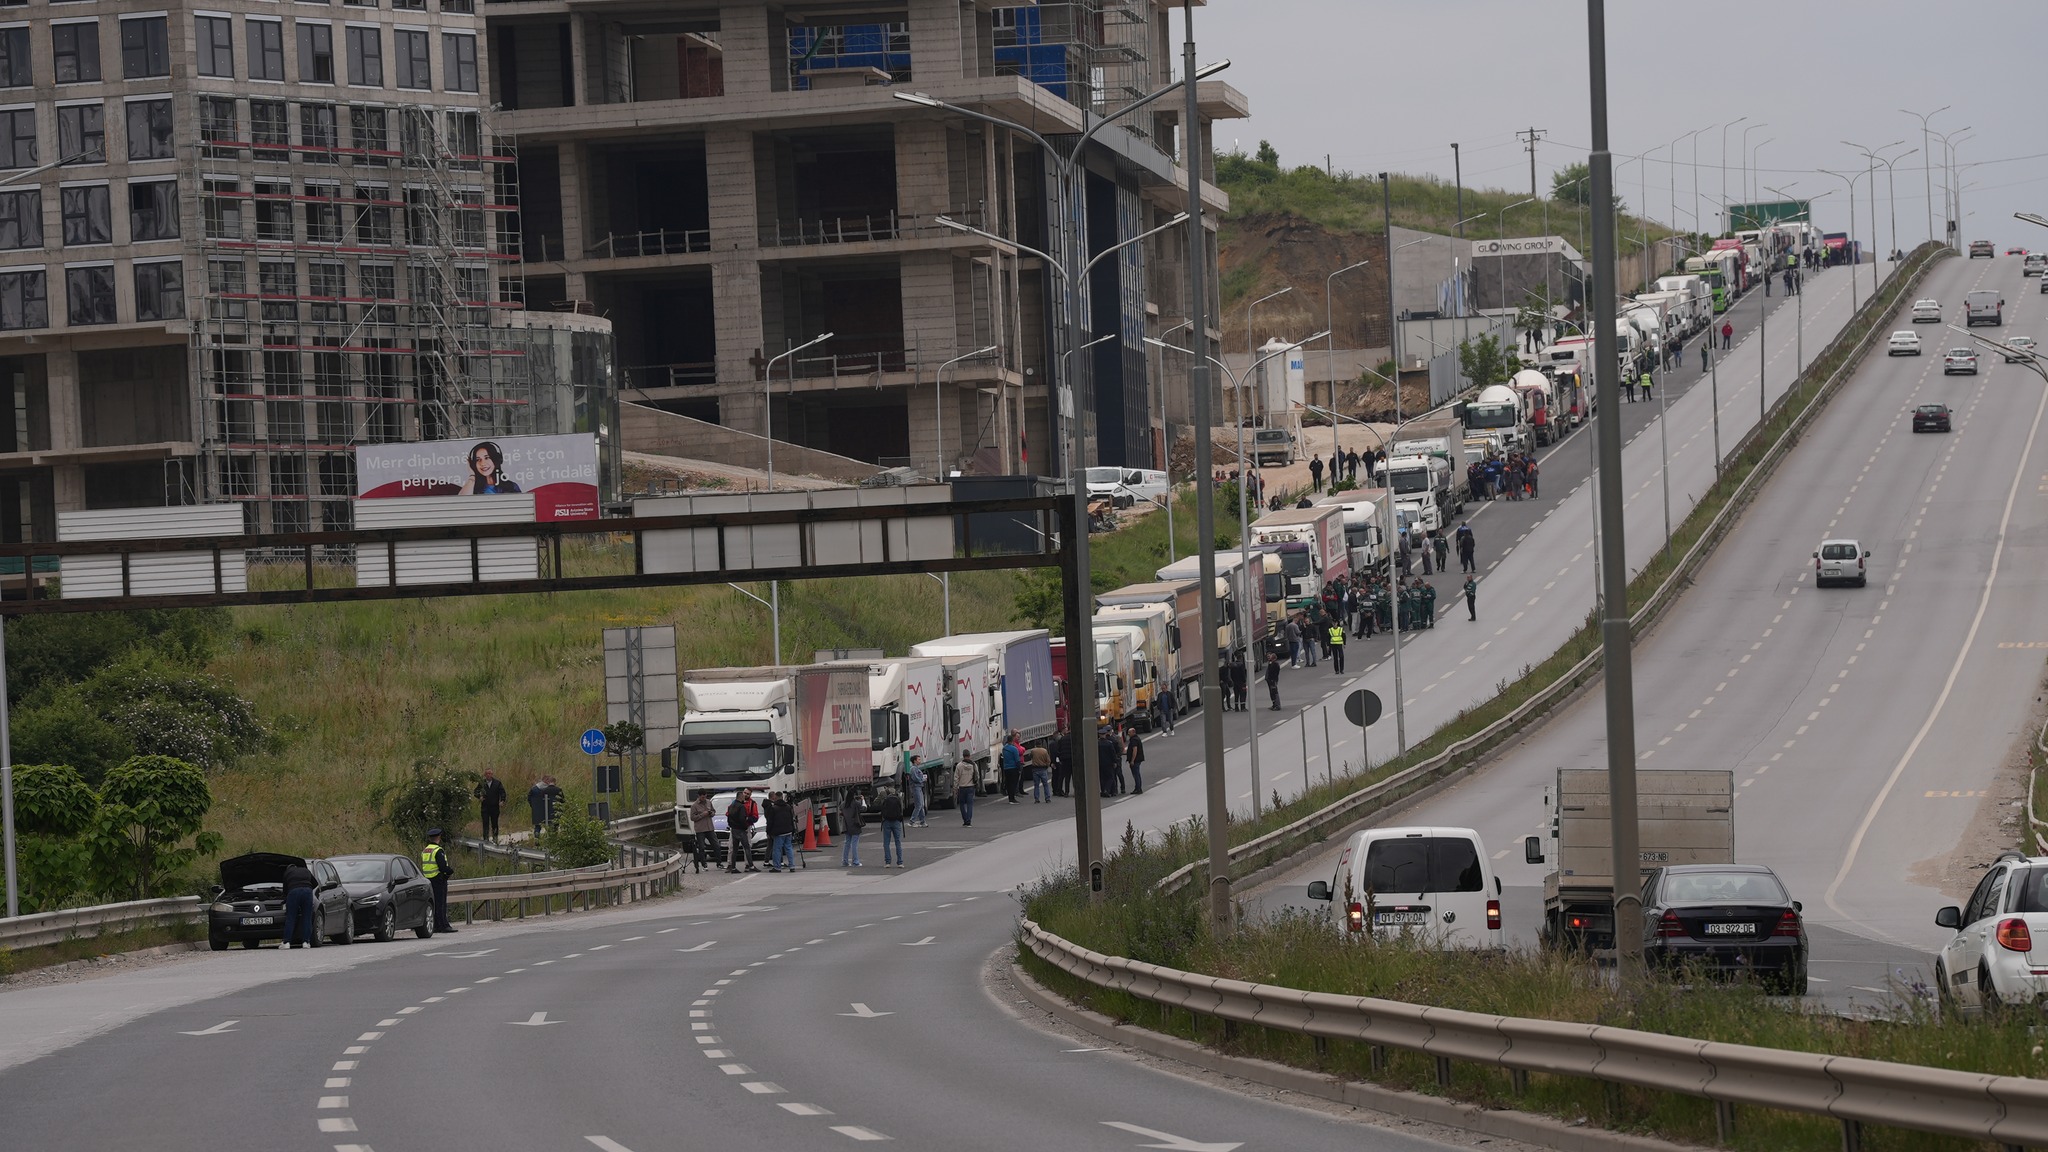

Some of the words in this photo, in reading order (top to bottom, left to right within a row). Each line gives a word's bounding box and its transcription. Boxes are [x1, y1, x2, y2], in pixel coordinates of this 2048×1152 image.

[1478, 242, 1522, 253] GLOWING
[1524, 241, 1553, 250] GROUP
[366, 456, 403, 470] Merr
[407, 451, 469, 473] diplomë
[504, 449, 520, 467] që
[495, 469, 510, 486] jo
[515, 468, 535, 485] që
[554, 509, 570, 517] ASU
